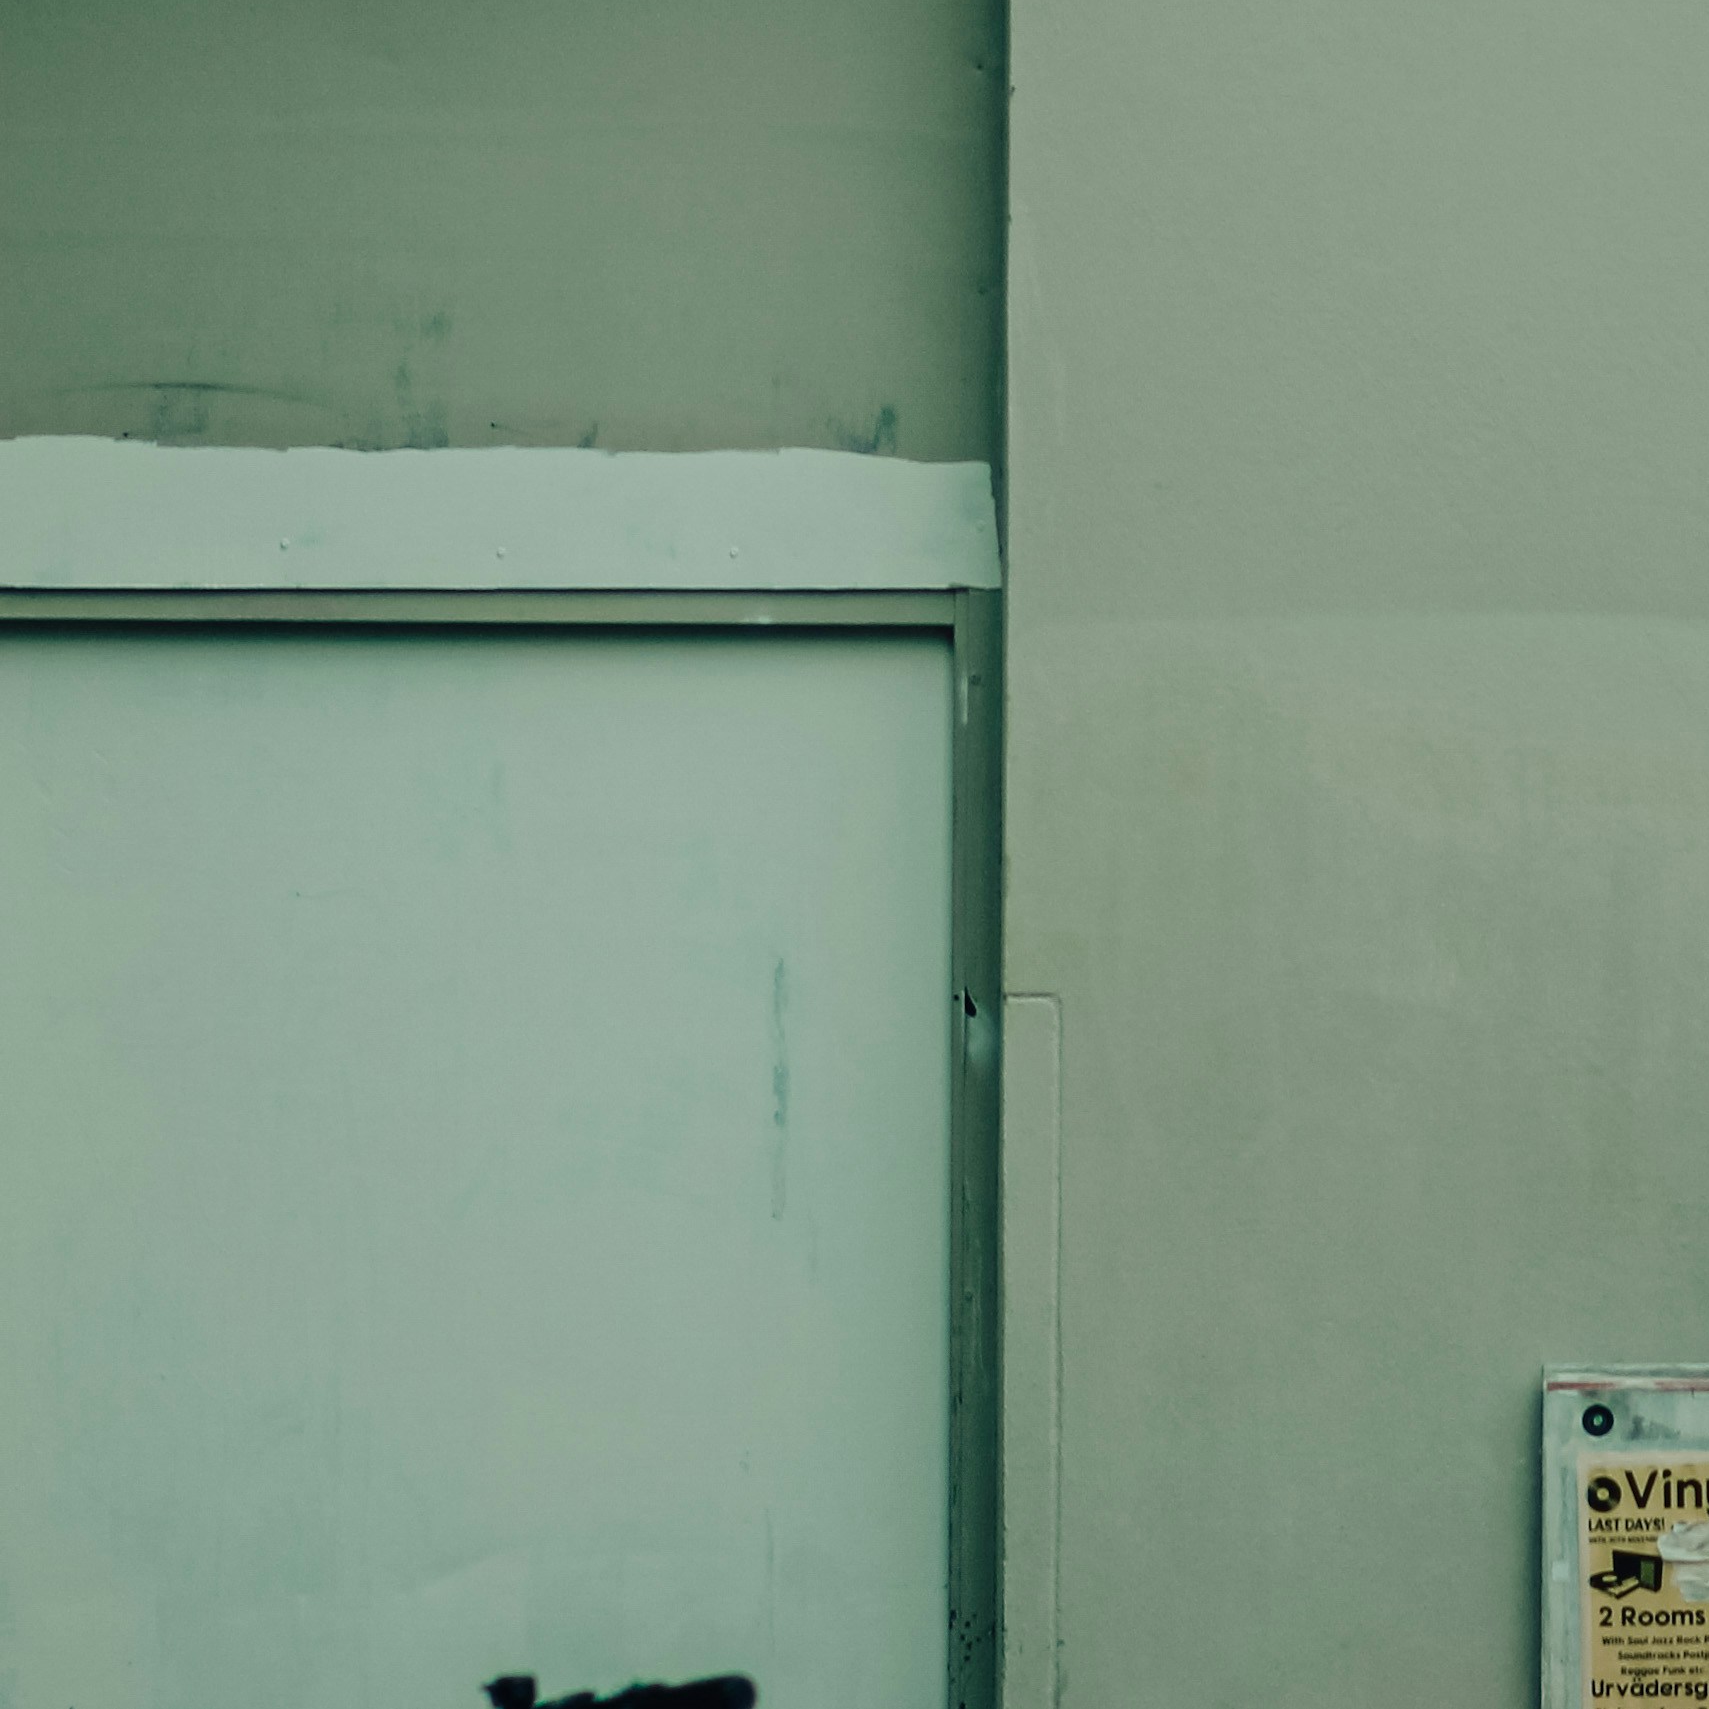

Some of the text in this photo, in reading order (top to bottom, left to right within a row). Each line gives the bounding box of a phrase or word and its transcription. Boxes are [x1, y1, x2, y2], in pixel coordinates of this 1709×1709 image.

[1588, 1517, 1665, 1532] LAST DAYS!
[1599, 1606, 1613, 1627] 2
[1621, 1606, 1706, 1627] Rooms
